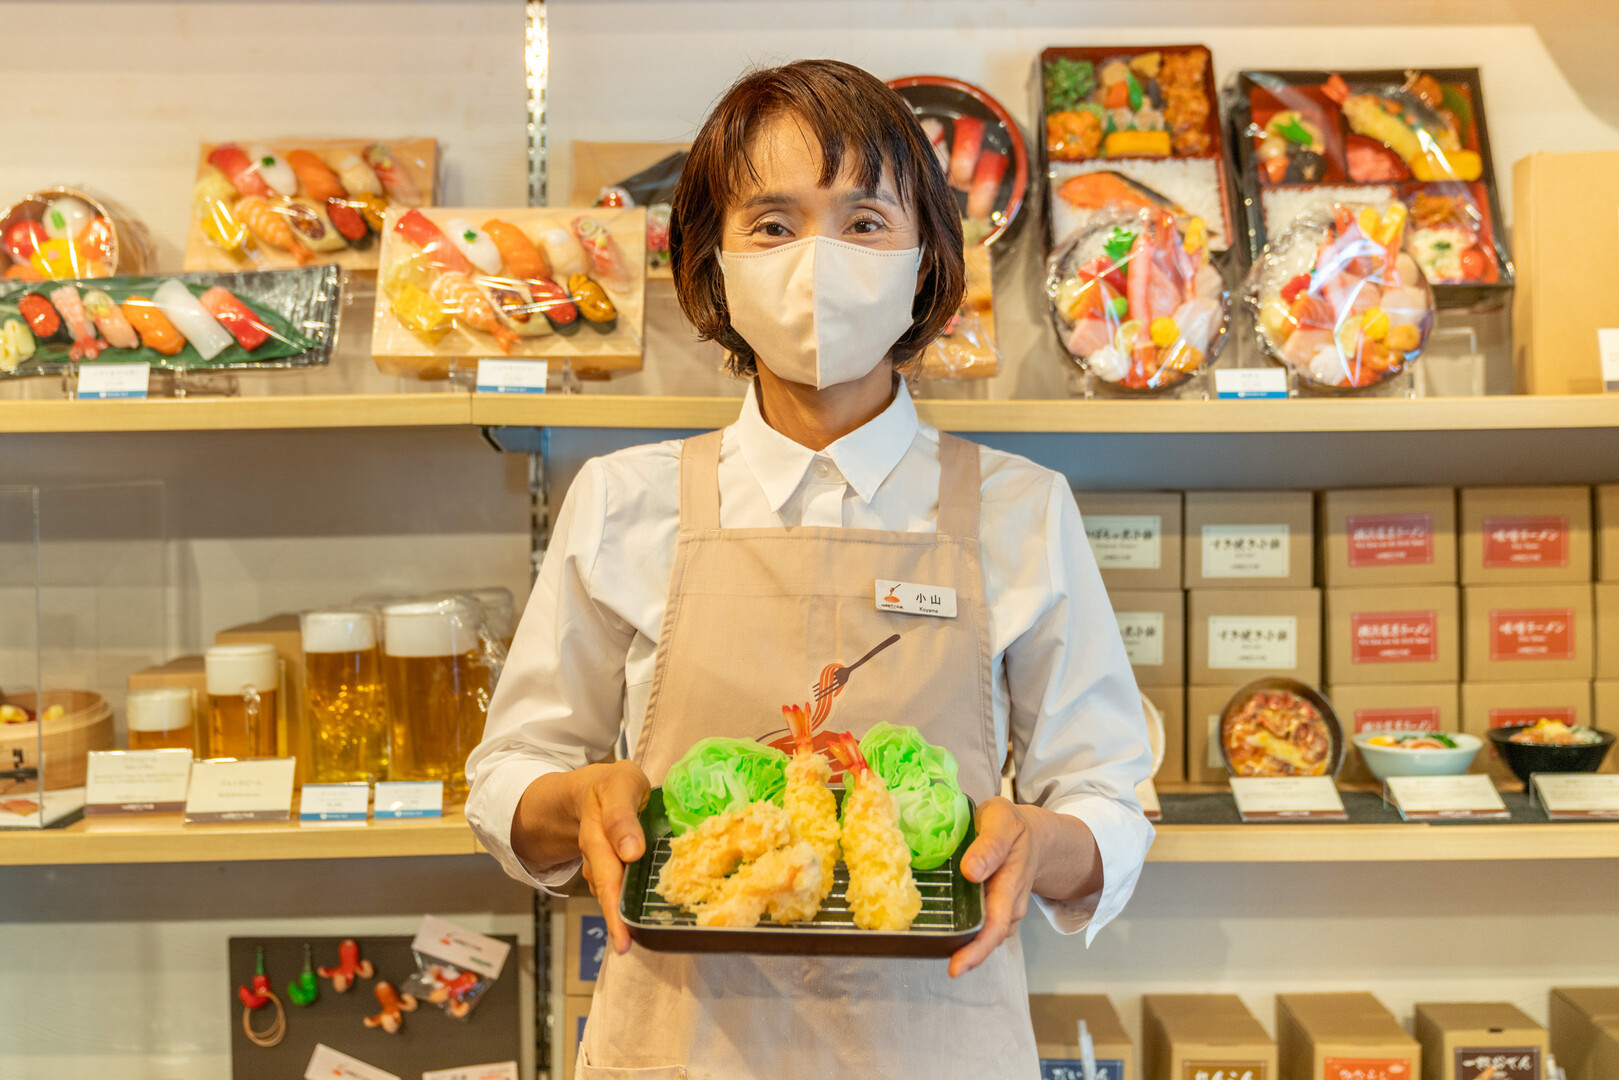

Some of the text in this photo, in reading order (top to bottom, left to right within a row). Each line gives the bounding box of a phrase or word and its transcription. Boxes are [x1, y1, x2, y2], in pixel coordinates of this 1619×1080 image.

[916, 593, 941, 605] 小山
[1499, 620, 1567, 636] 味噌ラーメン
